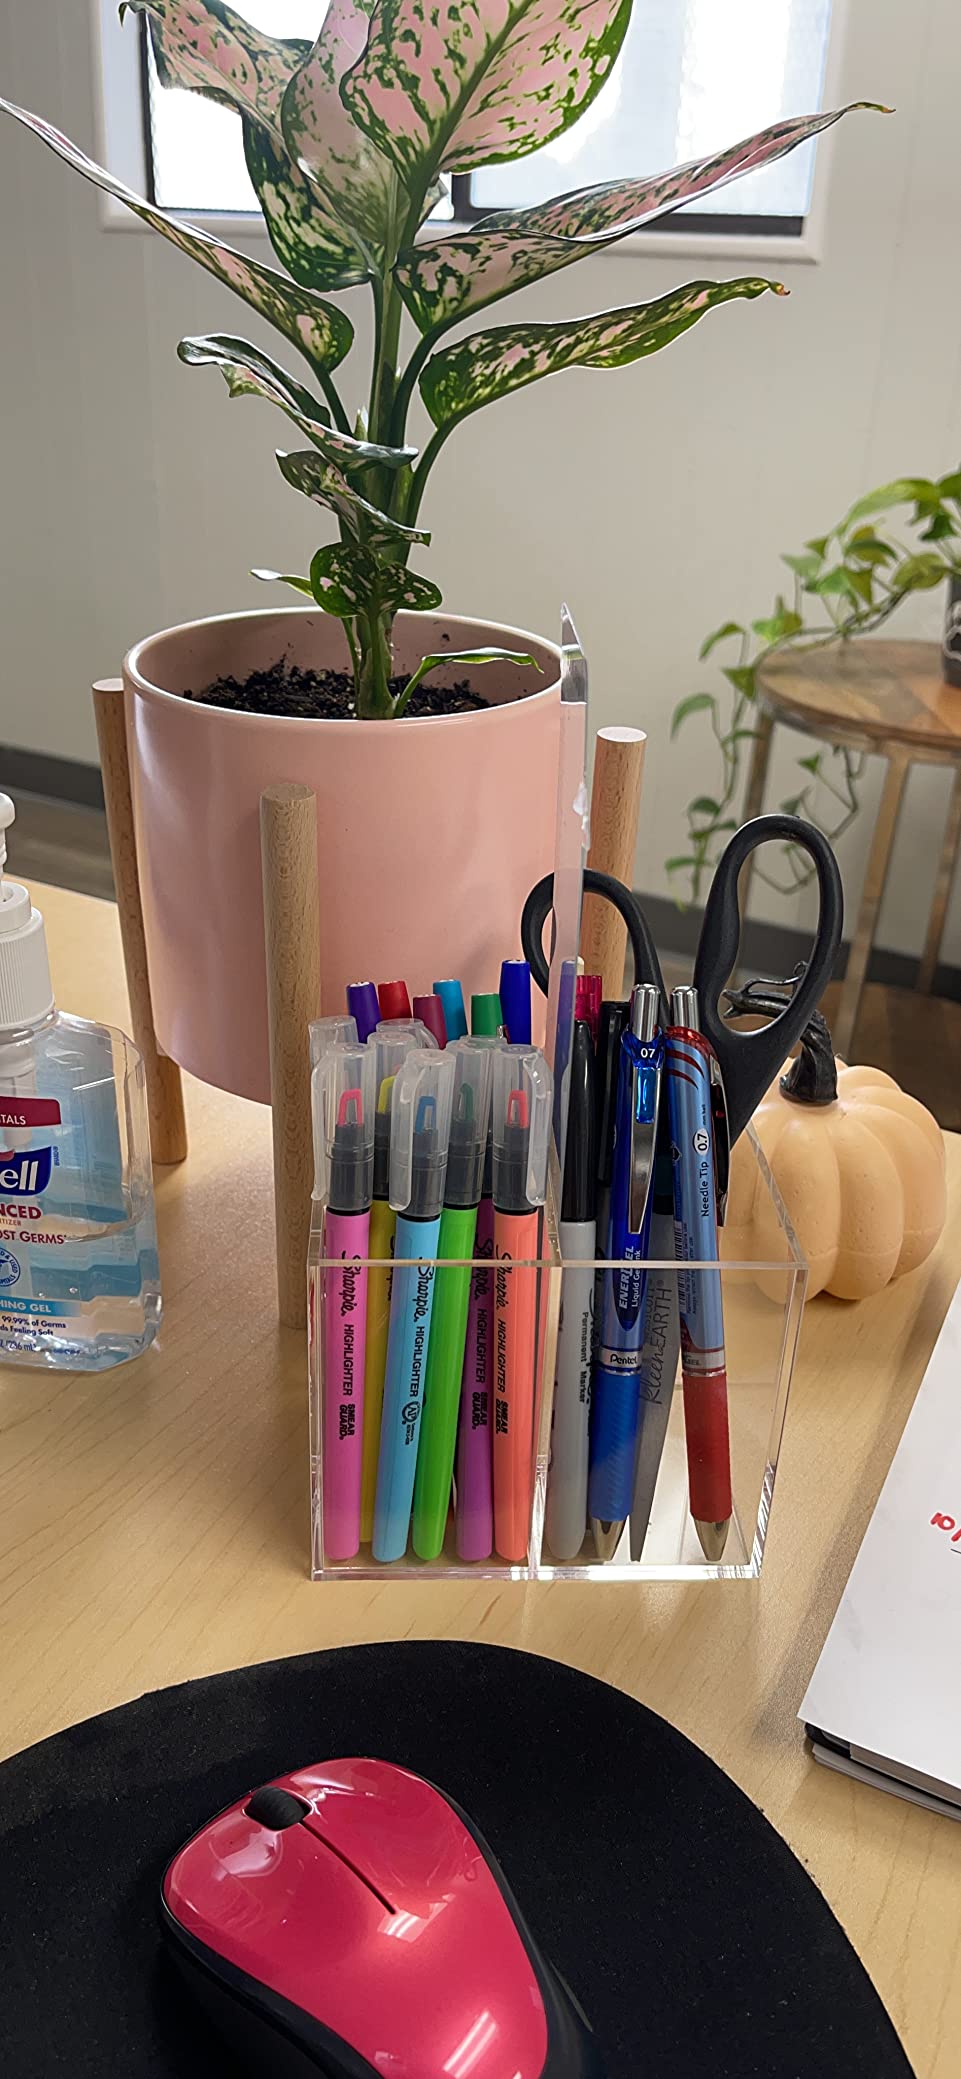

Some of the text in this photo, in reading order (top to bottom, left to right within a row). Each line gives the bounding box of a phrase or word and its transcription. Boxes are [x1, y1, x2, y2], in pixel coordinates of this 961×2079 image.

[640, 1047, 655, 1058] 07
[698, 1133, 708, 1151] 0.7
[700, 1161, 709, 1217] Needle Tip
[30, 1303, 52, 1313] GEL
[631, 1282, 640, 1307] Liquid
[41, 1319, 67, 1329] Germs
[343, 1324, 355, 1396] HIGHLIGHTER
[409, 1326, 425, 1397] HIGHLIGHTER
[476, 1308, 488, 1383] HIGHLIGHTER
[497, 1319, 507, 1393] HIGHLIGHTER
[579, 1312, 589, 1403] Permanent Marker
[610, 1353, 638, 1365] Pentel
[348, 1404, 356, 1436] SMEAR
